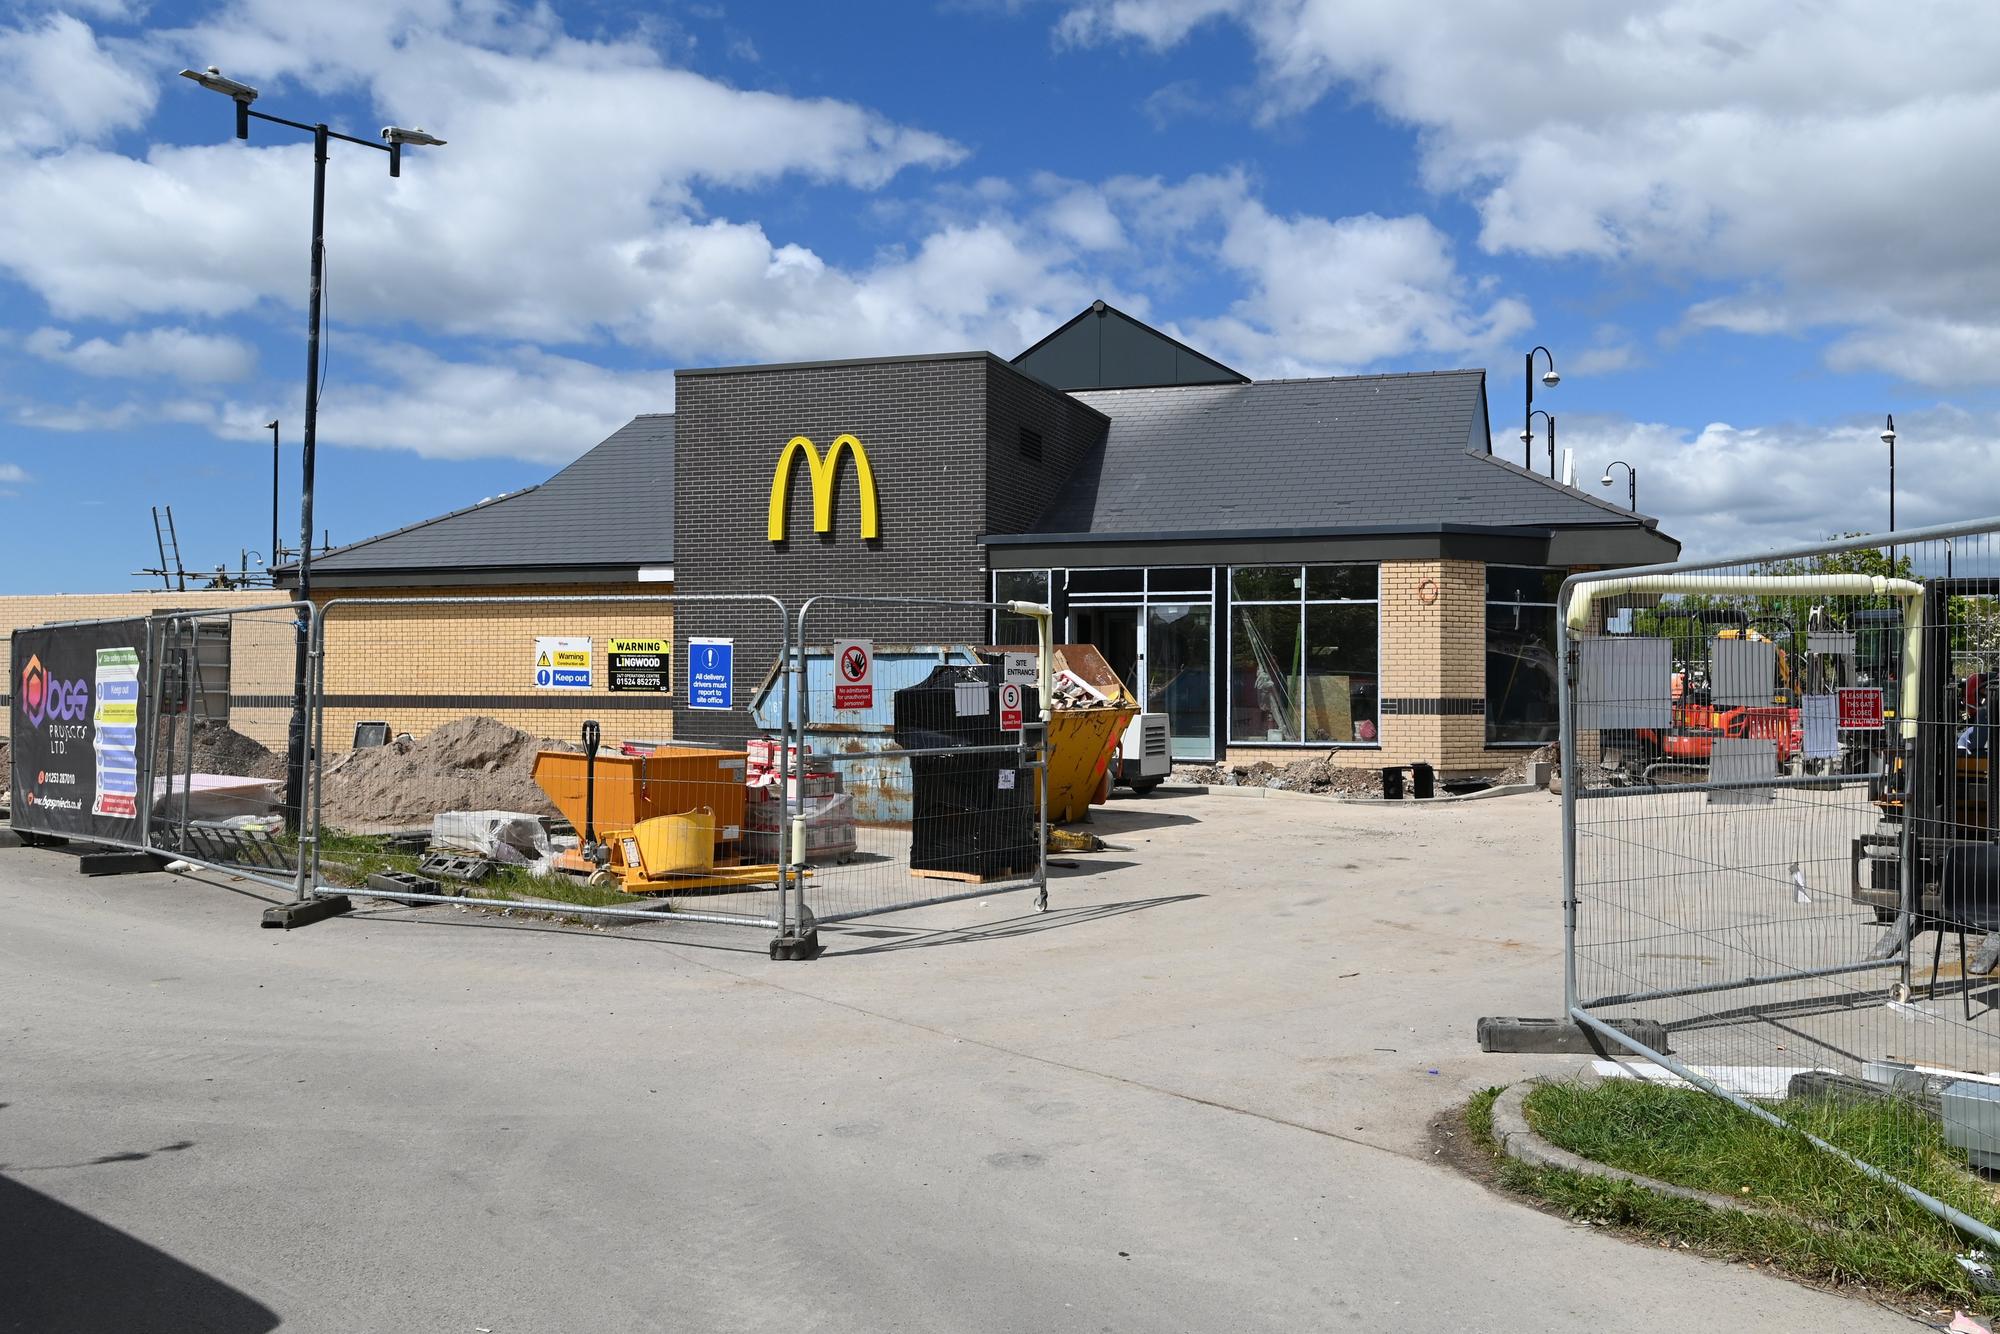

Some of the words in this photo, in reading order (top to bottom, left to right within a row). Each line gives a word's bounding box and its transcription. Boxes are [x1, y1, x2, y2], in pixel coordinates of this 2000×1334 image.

[616, 642, 660, 652] WARNING
[558, 652, 584, 661] Warning
[616, 657, 660, 667] LINGWOOD
[555, 673, 574, 683] Keep
[703, 673, 724, 682] delivery
[111, 686, 121, 696] Keep
[1008, 692, 1014, 702] 5
[50, 724, 87, 741] PROJECTS
[51, 741, 67, 754] LTD.
